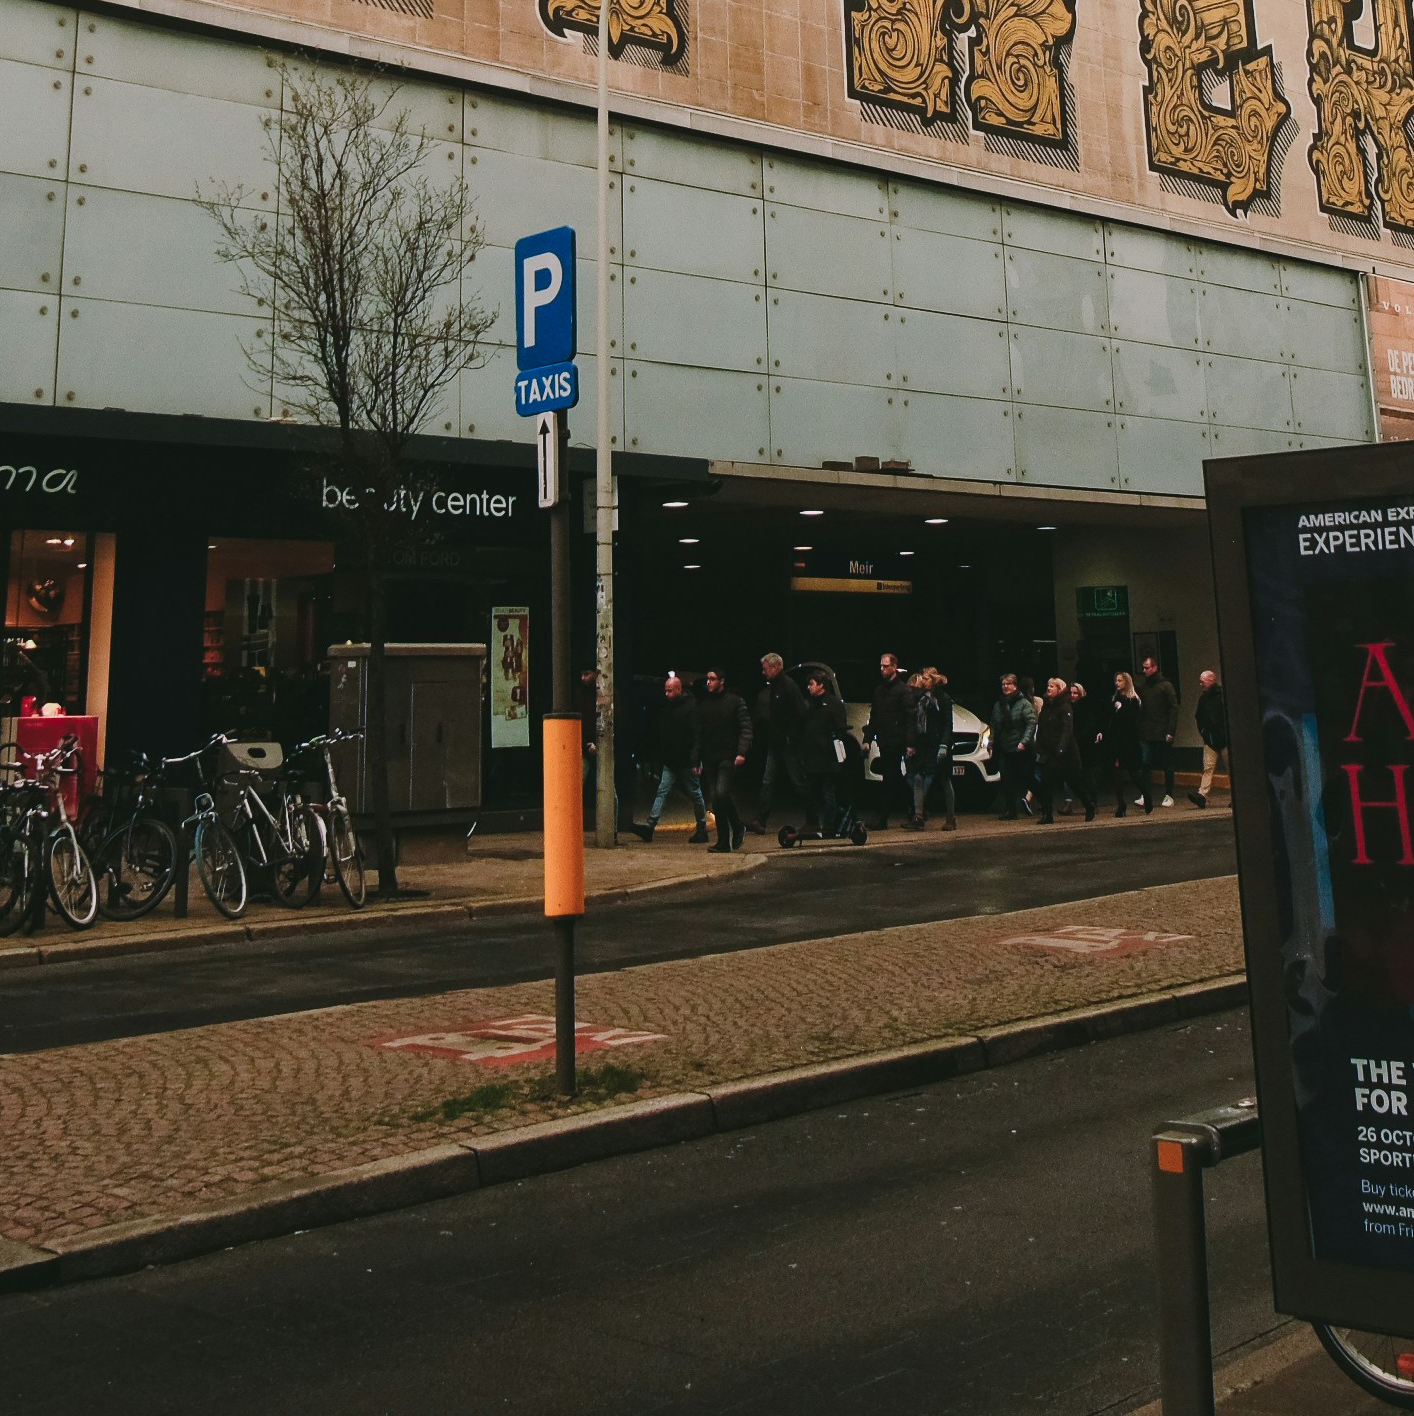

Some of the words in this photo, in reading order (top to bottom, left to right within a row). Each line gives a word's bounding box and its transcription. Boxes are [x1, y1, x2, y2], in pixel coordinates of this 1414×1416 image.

[523, 252, 563, 348] P
[1386, 349, 1401, 372] DE
[517, 371, 572, 405] TAXIS
[432, 489, 517, 517] center
[1298, 509, 1383, 529] AMERICAN
[387, 551, 416, 566] OM
[849, 560, 874, 575] Meir
[1350, 1058, 1407, 1086] THE
[1354, 1087, 1408, 1116] FOR
[1357, 1126, 1377, 1142] 26
[1361, 1179, 1386, 1198] Buy
[1363, 1219, 1396, 1236] from
